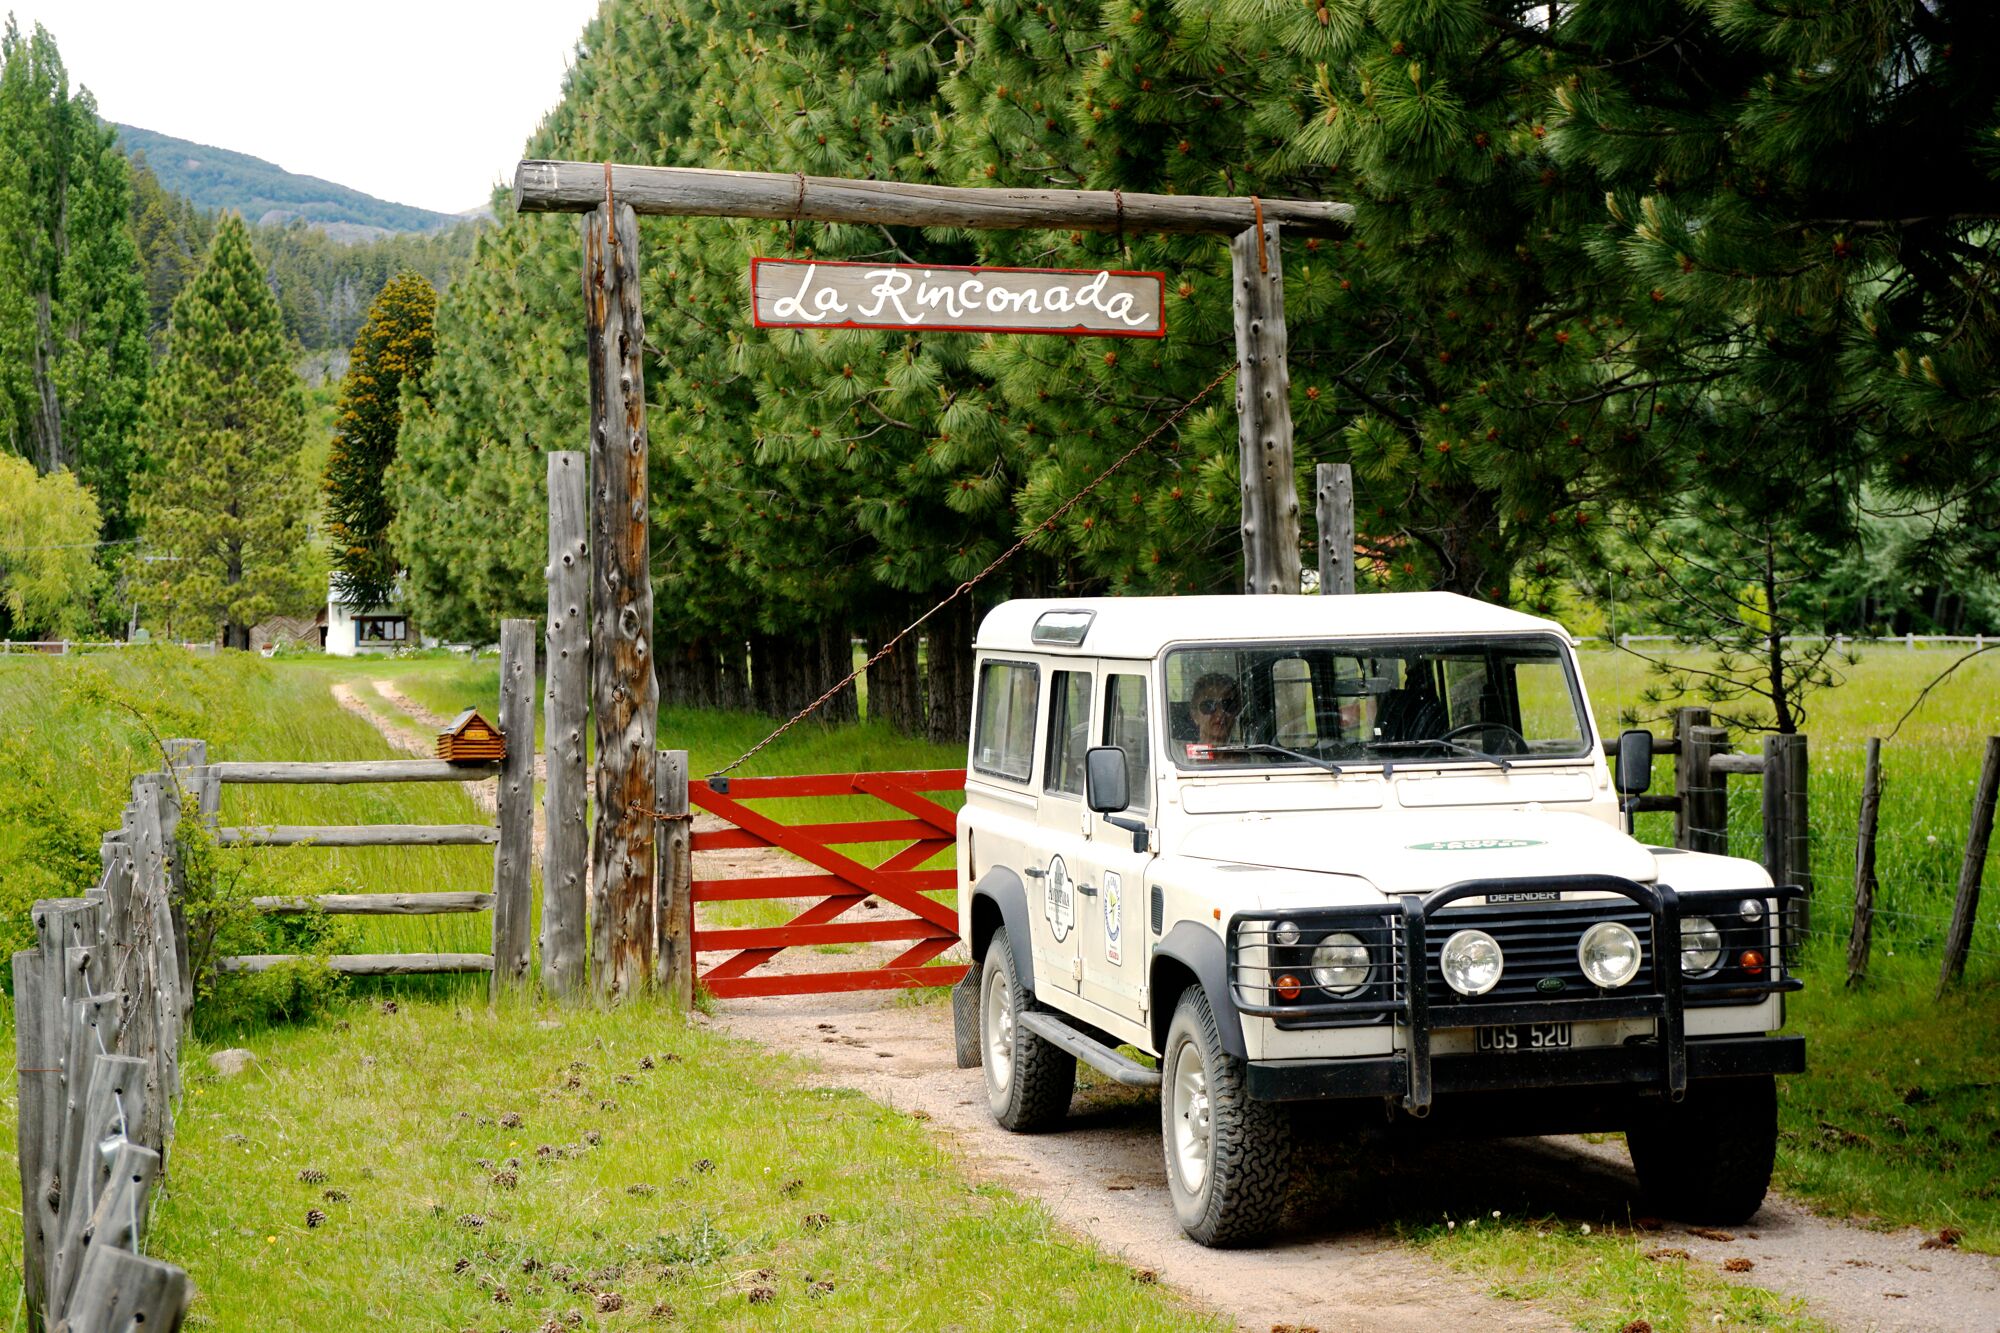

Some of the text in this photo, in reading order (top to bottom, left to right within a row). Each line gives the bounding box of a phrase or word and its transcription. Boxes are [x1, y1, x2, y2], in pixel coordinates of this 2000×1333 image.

[773, 264, 1151, 325] La Rinconada
[1489, 892, 1556, 902] DEFENDER
[1531, 1023, 1569, 1048] 520
